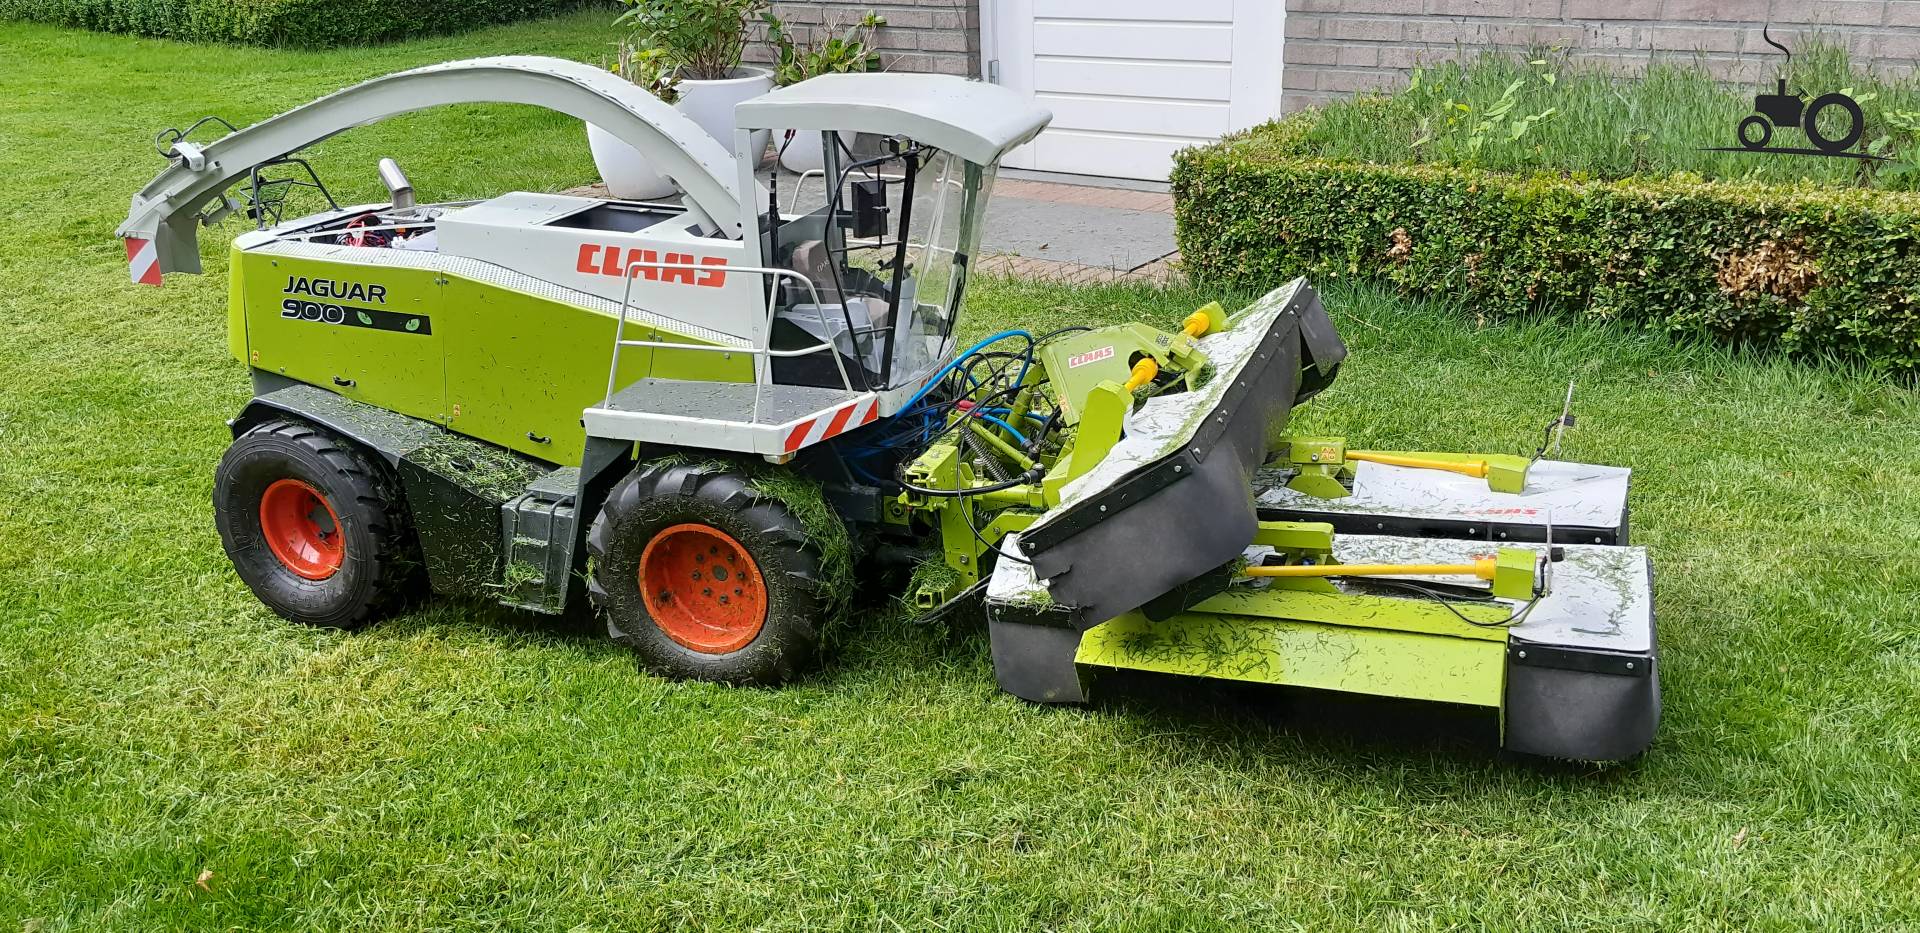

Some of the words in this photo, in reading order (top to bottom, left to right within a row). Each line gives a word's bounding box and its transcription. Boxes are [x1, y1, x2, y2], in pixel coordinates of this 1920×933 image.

[576, 243, 728, 288] CLAAS
[283, 274, 387, 304] JAGUAR
[281, 299, 344, 324] 900
[1070, 347, 1112, 367] CLAAS
